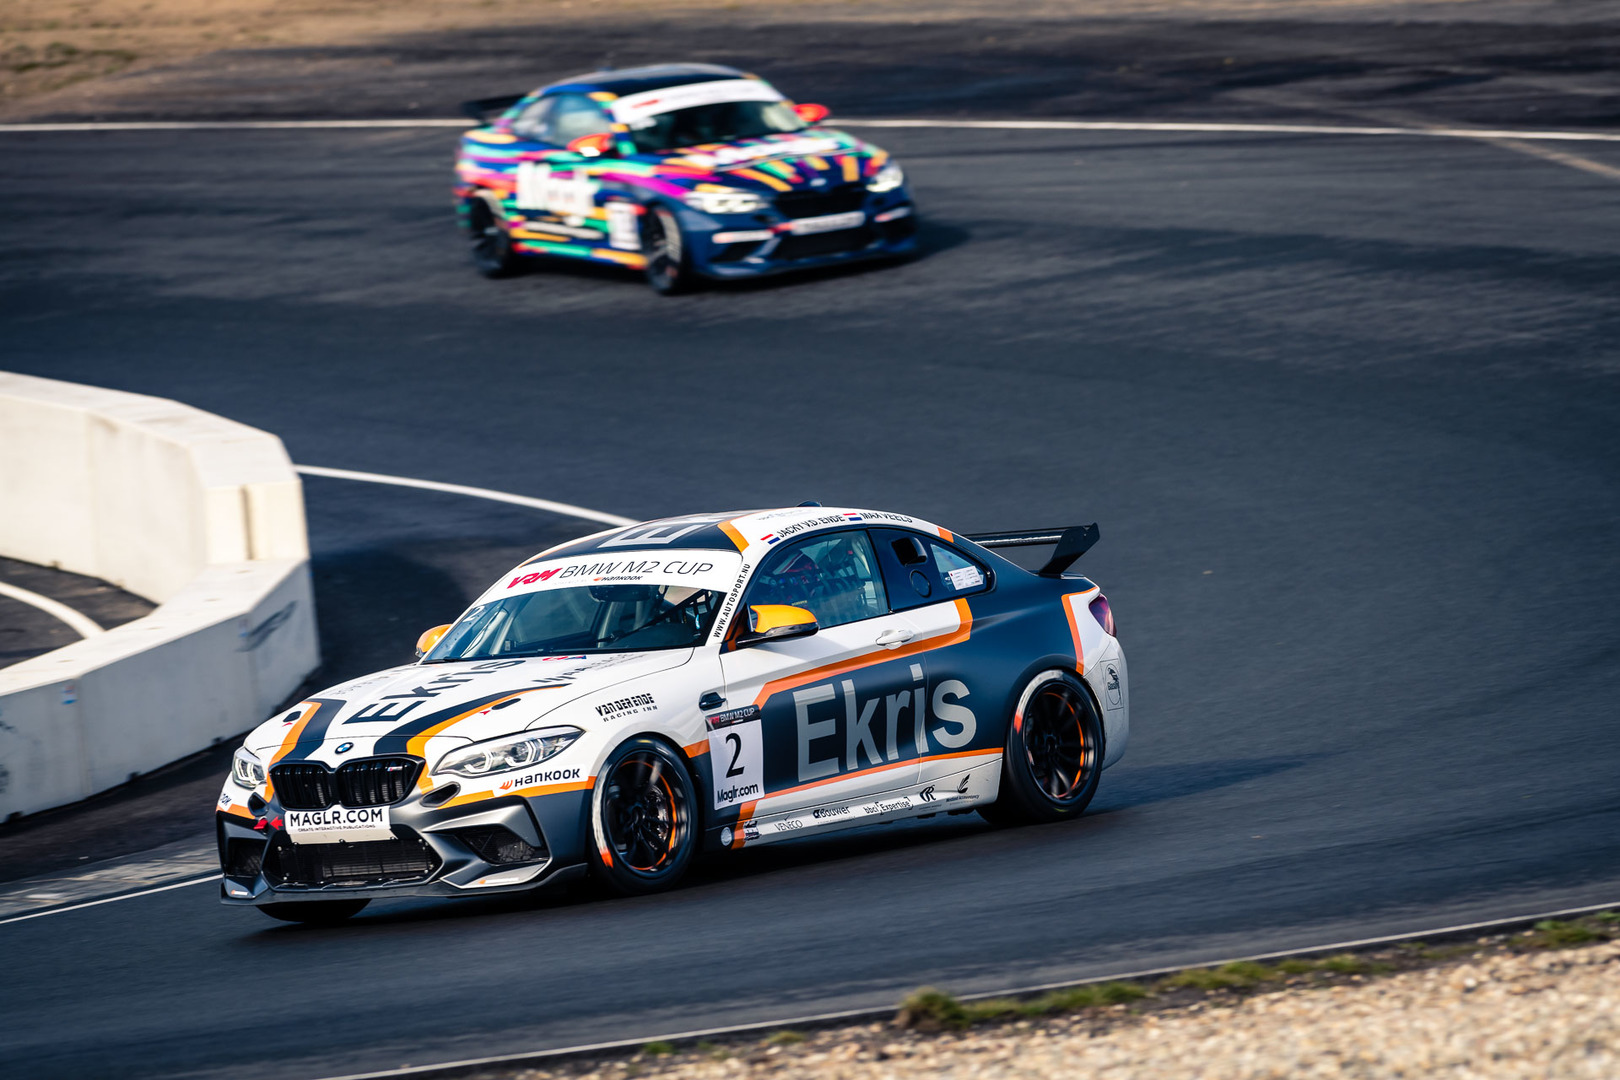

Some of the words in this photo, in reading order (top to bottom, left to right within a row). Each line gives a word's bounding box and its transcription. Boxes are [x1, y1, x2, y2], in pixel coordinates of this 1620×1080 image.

[559, 562, 622, 579] BMW
[622, 561, 660, 574] M2
[662, 561, 713, 576] CUP
[603, 709, 639, 722] RACING
[720, 712, 735, 723] BMW
[743, 707, 755, 717] CUP
[792, 663, 977, 782] Ekris
[725, 732, 745, 778] 2
[716, 783, 759, 803] Maglr.com
[290, 808, 383, 827] MAGLR.COM
